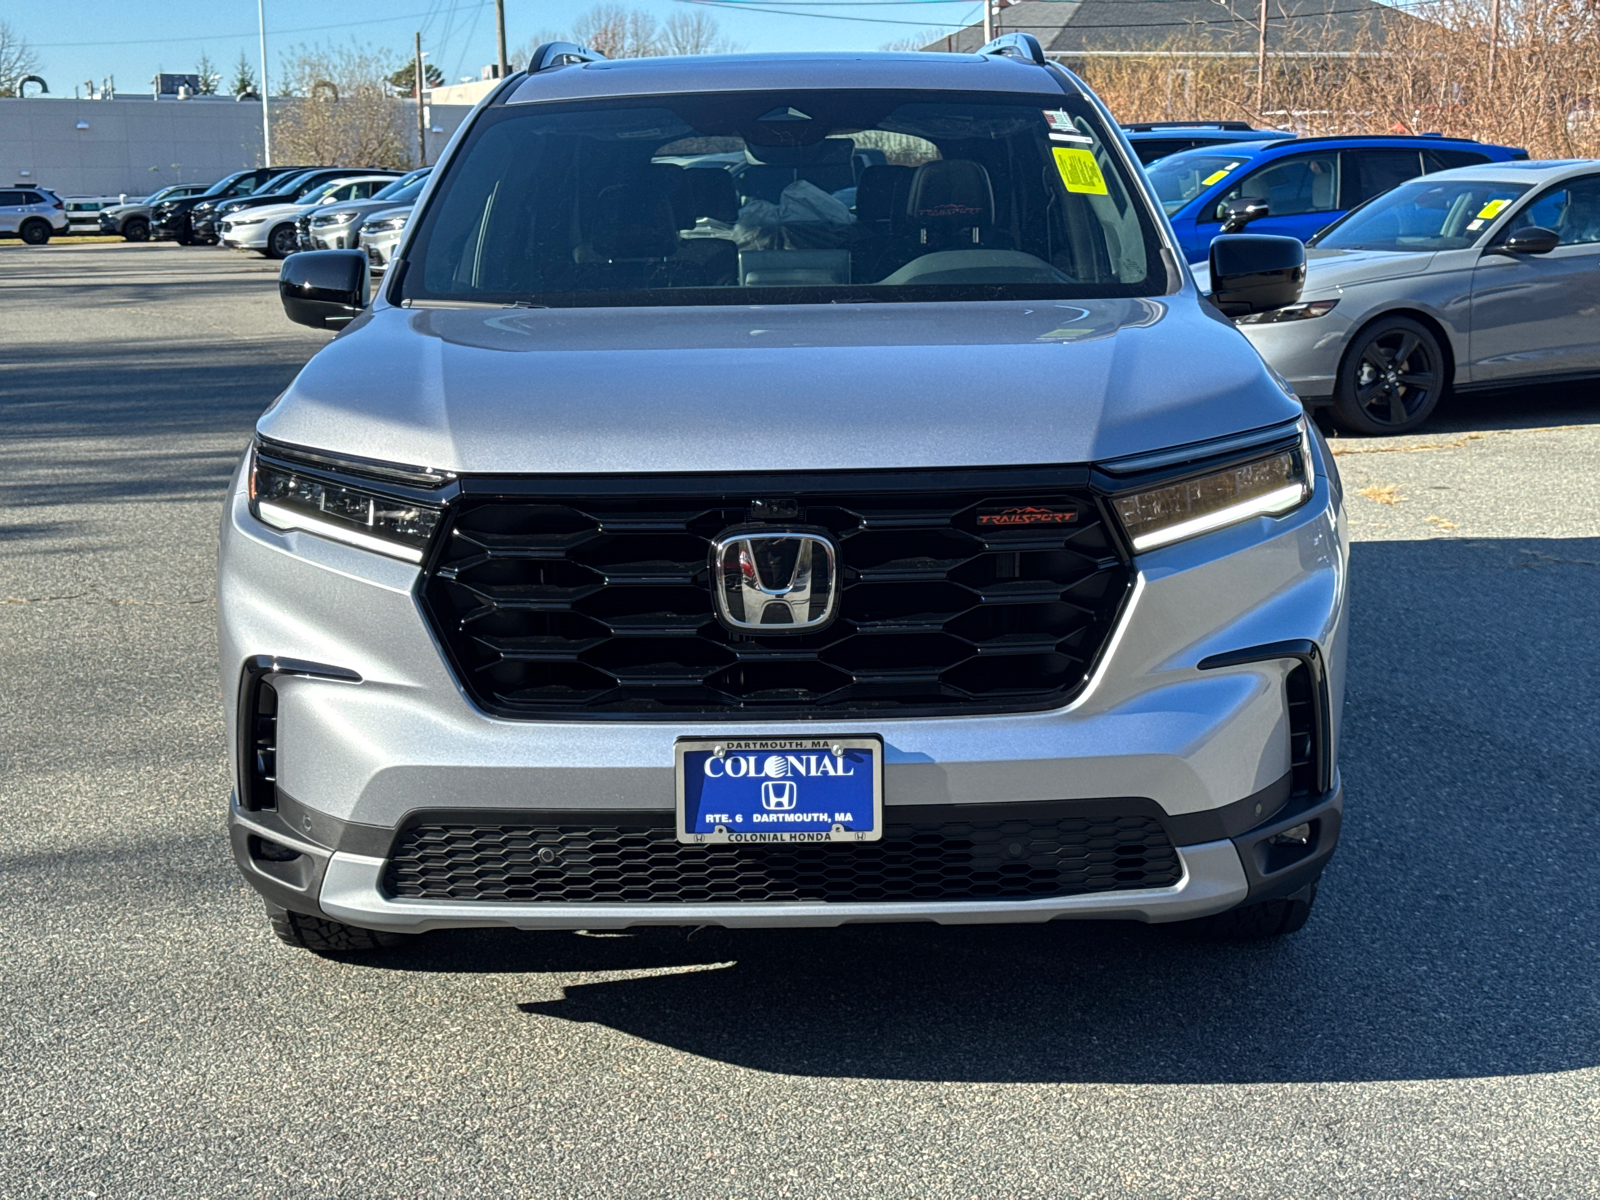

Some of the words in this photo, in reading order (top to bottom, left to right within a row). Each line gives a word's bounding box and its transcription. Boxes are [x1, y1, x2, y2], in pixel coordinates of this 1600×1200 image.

[979, 512, 1075, 524] TRAILSPORT
[726, 741, 807, 750] DARTMOUTH,
[811, 740, 830, 748] MA
[703, 755, 854, 779] COLONIAL
[705, 813, 733, 824] RTE.
[735, 813, 743, 823] 6
[752, 813, 832, 824] DARTMOUTH,
[835, 812, 853, 822] MA
[727, 832, 786, 843] COLONIAL
[789, 832, 832, 842] HONDA
